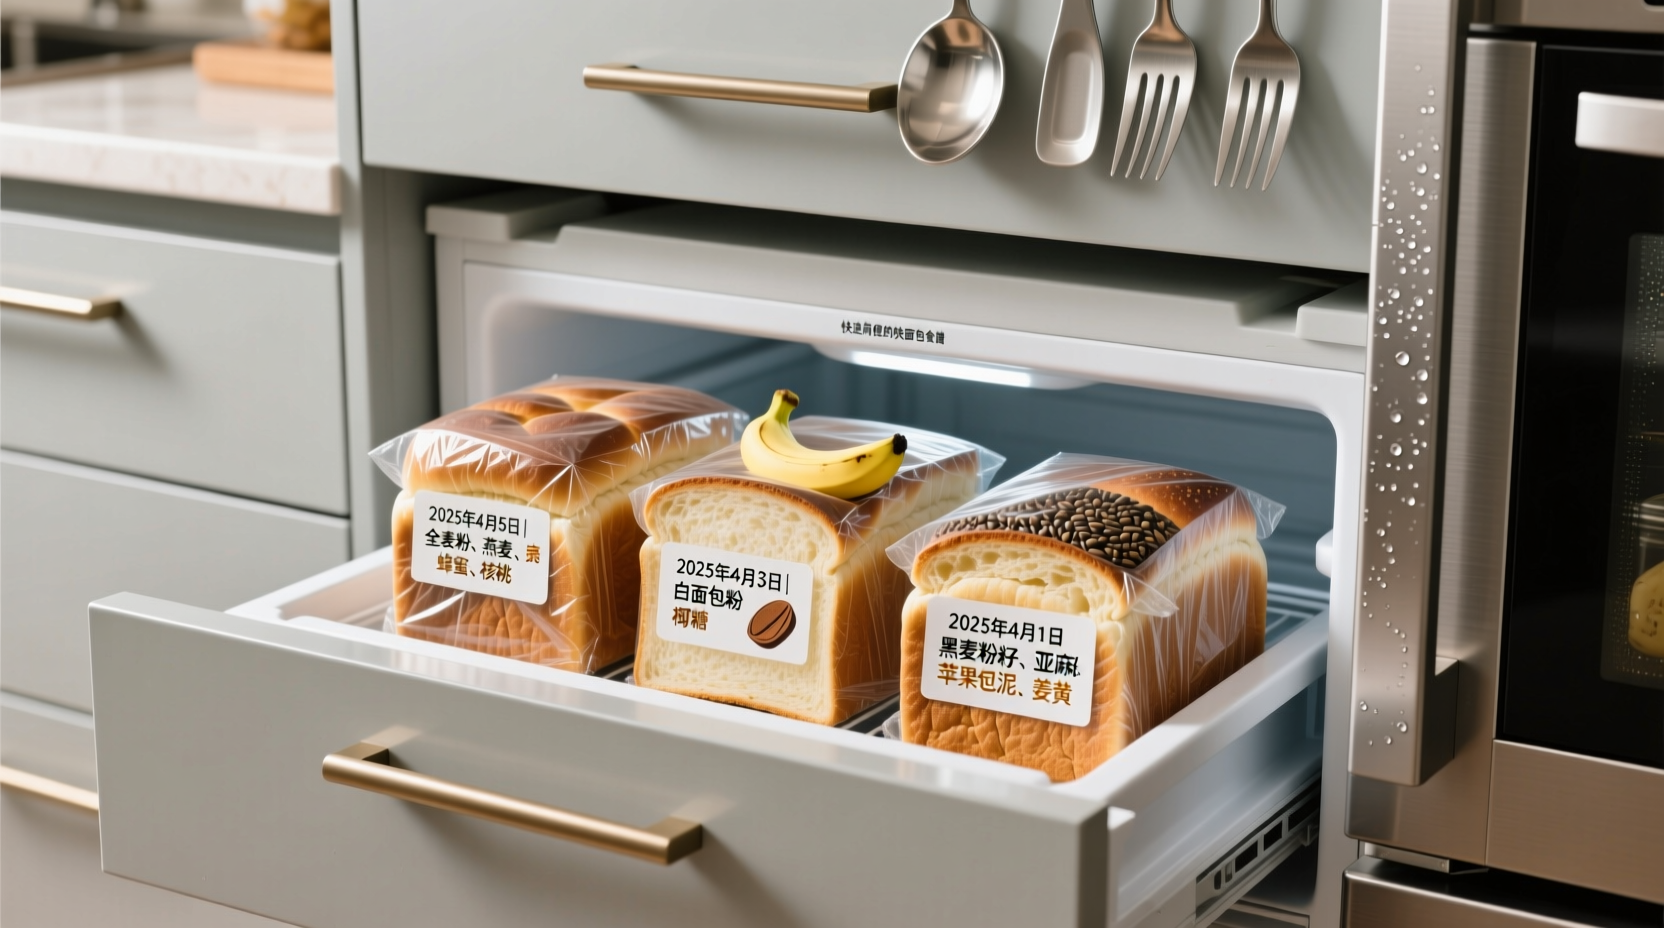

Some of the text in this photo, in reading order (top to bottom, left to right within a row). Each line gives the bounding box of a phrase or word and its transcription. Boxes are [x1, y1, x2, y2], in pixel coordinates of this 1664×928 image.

[674, 581, 743, 611] 白面包粉
[948, 613, 1063, 647] 2025年4月1日
